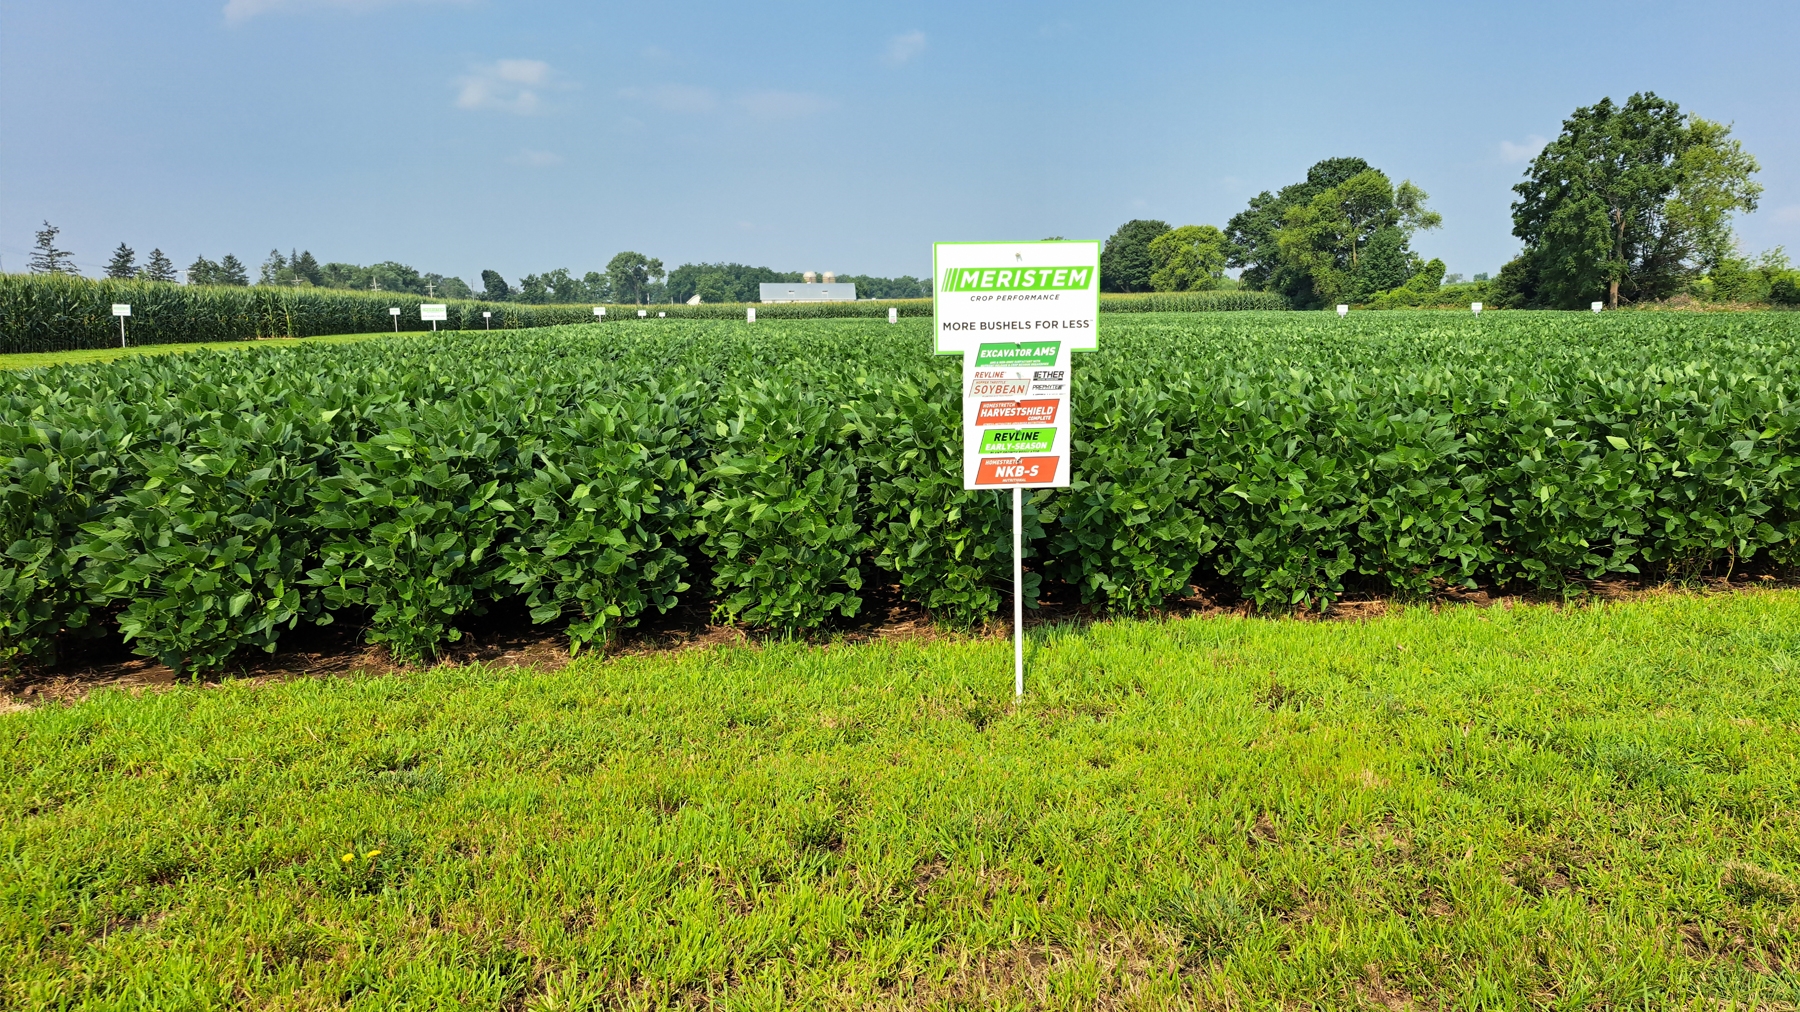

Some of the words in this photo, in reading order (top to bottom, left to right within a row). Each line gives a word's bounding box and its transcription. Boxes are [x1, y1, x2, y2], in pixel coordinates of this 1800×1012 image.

[960, 269, 1088, 289] MERISTEM
[943, 321, 976, 331] MORE
[980, 320, 1031, 330] BUSHELS
[1035, 320, 1058, 329] FOR
[1062, 319, 1090, 329] LESS
[980, 349, 1031, 358] EXCAVATOR
[1031, 347, 1056, 356] AMS
[974, 385, 1025, 395] SOYBEAN
[980, 406, 1053, 417] HARVESTSHIELD
[994, 431, 1040, 441] REVLINE
[985, 442, 1047, 451] EARLY-SEASON
[995, 465, 1039, 478] NKB-S
